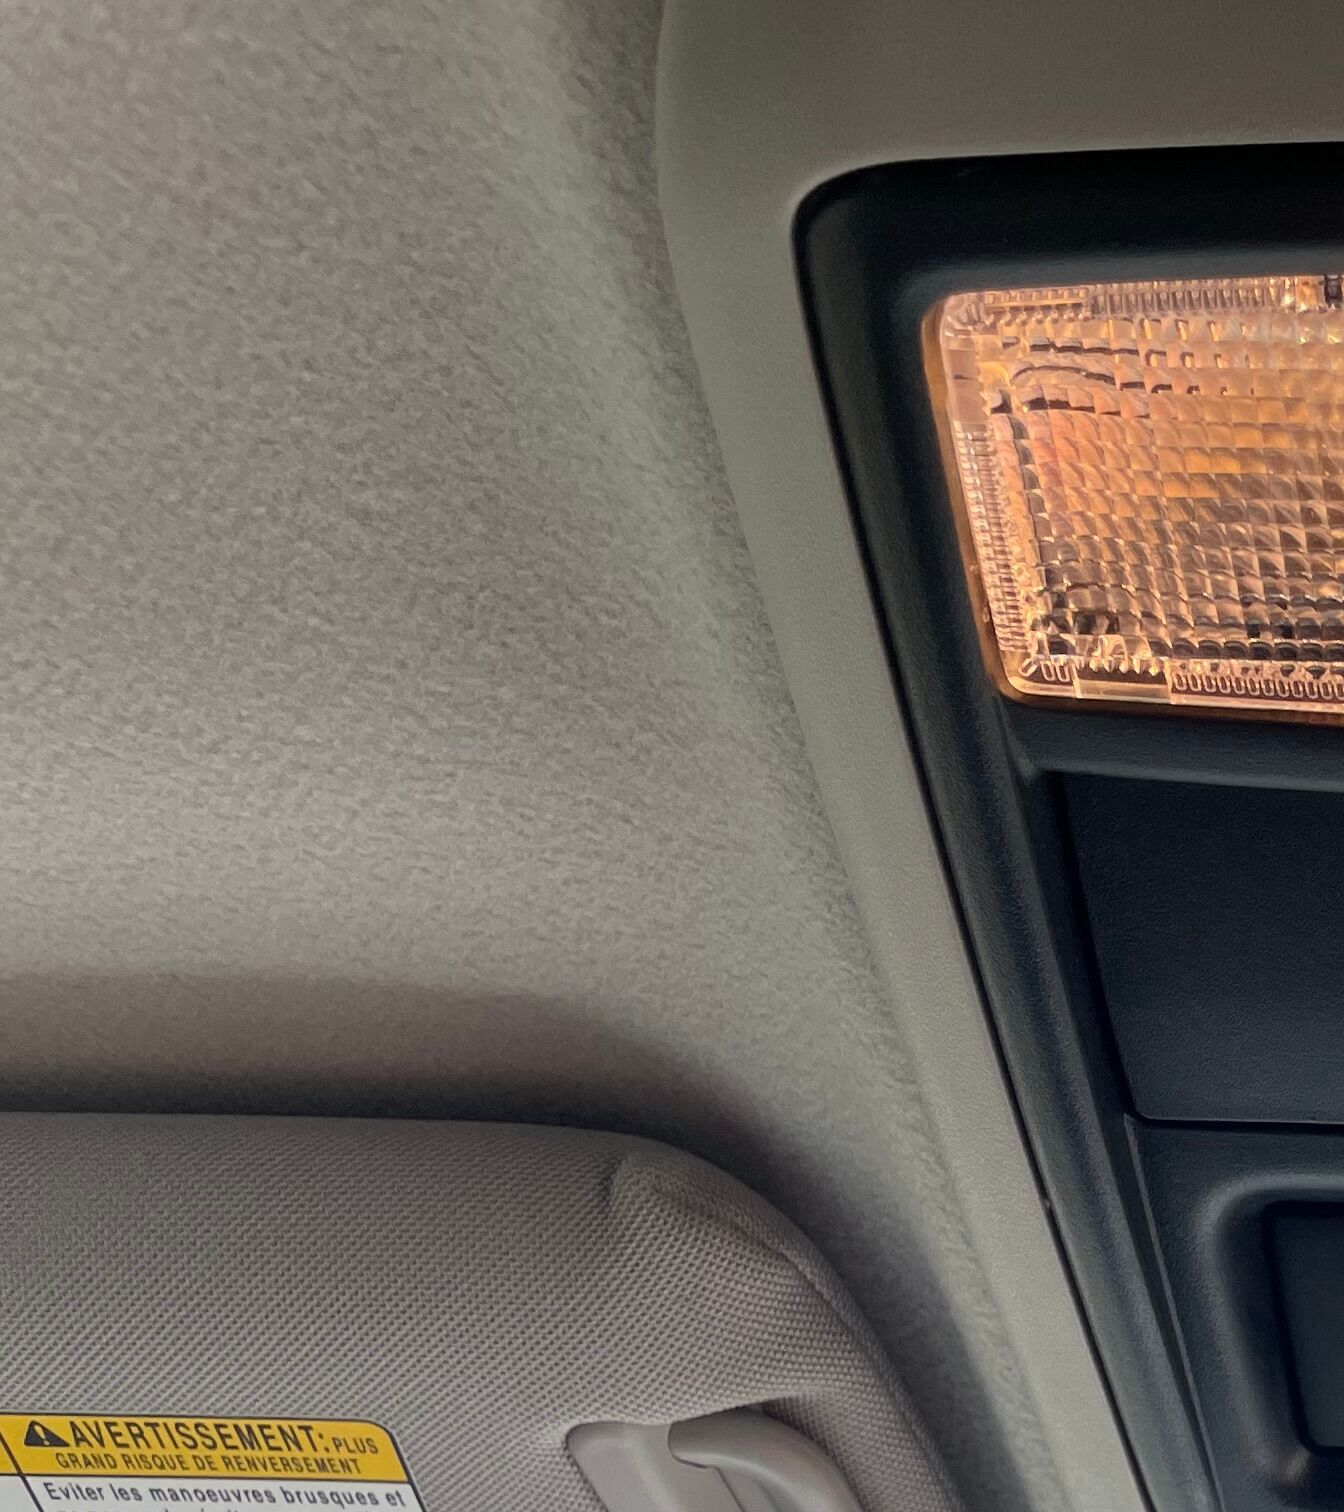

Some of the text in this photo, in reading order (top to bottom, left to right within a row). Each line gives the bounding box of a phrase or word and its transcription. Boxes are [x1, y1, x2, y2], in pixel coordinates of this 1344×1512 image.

[70, 1420, 379, 1455] AVERTISSEMENT: PLUS
[55, 1452, 362, 1475] GRAND RISQUE DE RENVERSEMENT
[109, 1483, 142, 1502] les
[148, 1487, 277, 1504] manoeuvres
[280, 1486, 380, 1510] brusques
[385, 1490, 407, 1507] et
